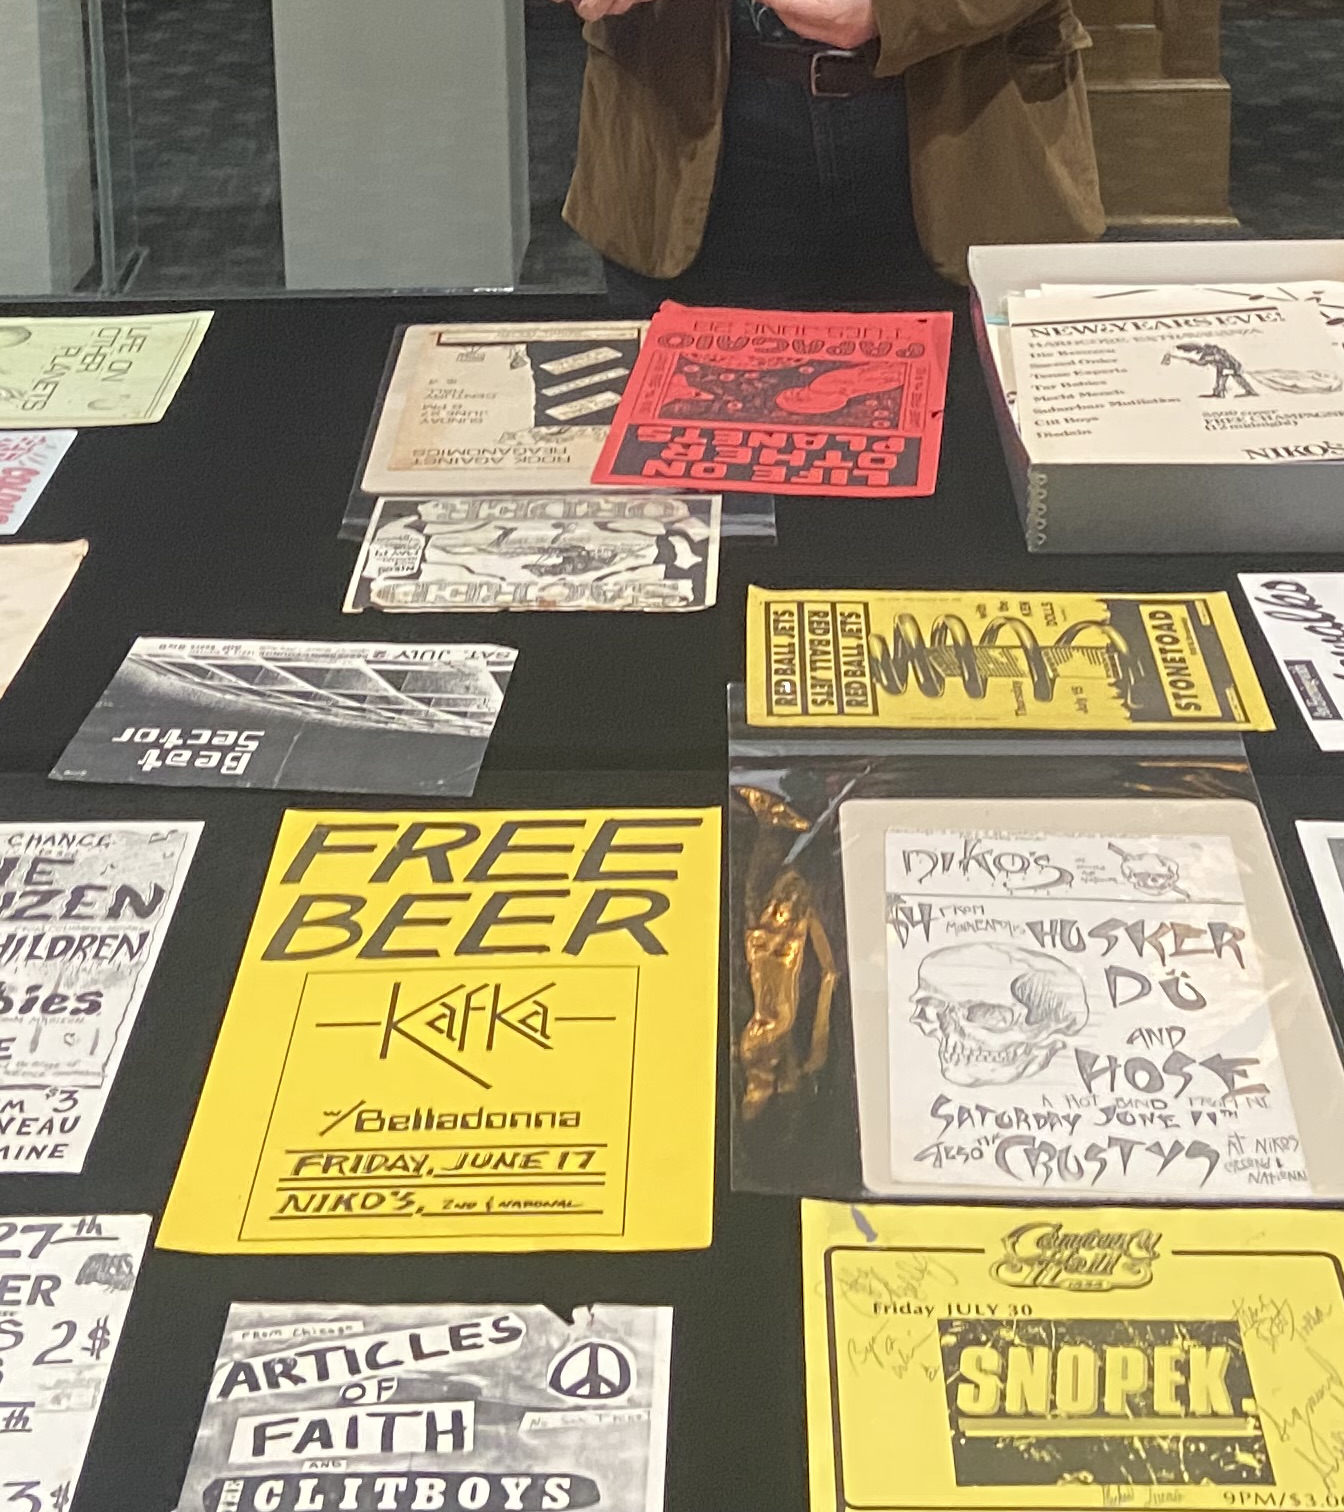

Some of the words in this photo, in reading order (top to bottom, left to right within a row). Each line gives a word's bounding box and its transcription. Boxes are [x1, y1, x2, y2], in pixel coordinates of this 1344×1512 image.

[632, 424, 906, 453] PLANETS
[639, 459, 728, 479] ON
[657, 442, 898, 469] OTHER
[748, 464, 889, 485] LIFE
[773, 609, 795, 638] JETS
[807, 609, 830, 635] RED
[839, 611, 863, 640] JETS
[393, 648, 451, 660] JULY
[773, 641, 796, 675] BALL
[808, 638, 832, 671] BALL
[841, 644, 866, 677] BALL
[1146, 610, 1204, 711] STONETOAD
[810, 677, 834, 706] JETS
[843, 679, 869, 707] RED
[107, 724, 265, 752] Sector
[131, 747, 254, 775] Beat
[7, 833, 113, 848] CHANCE
[279, 817, 705, 886] FREE
[259, 888, 672, 961] BEER
[1025, 918, 1246, 970] HUSKER
[1126, 1026, 1187, 1050] AND
[1073, 1046, 1271, 1100] HOSE
[929, 1093, 1083, 1140] SATURDAY
[1093, 1104, 1181, 1130] JUNE
[290, 1153, 435, 1176] FRIDAY,
[442, 1150, 550, 1172] JUNE
[556, 1150, 597, 1170] 17
[993, 1133, 1220, 1190] CRUSTYS
[872, 1300, 936, 1318] Friday
[945, 1301, 1001, 1319] JULY
[1007, 1301, 1034, 1318] 30
[216, 1314, 525, 1398] ARTICLES
[340, 1377, 398, 1403] OF
[954, 1344, 1235, 1418] SNOPEK
[251, 1409, 467, 1458] FAITH
